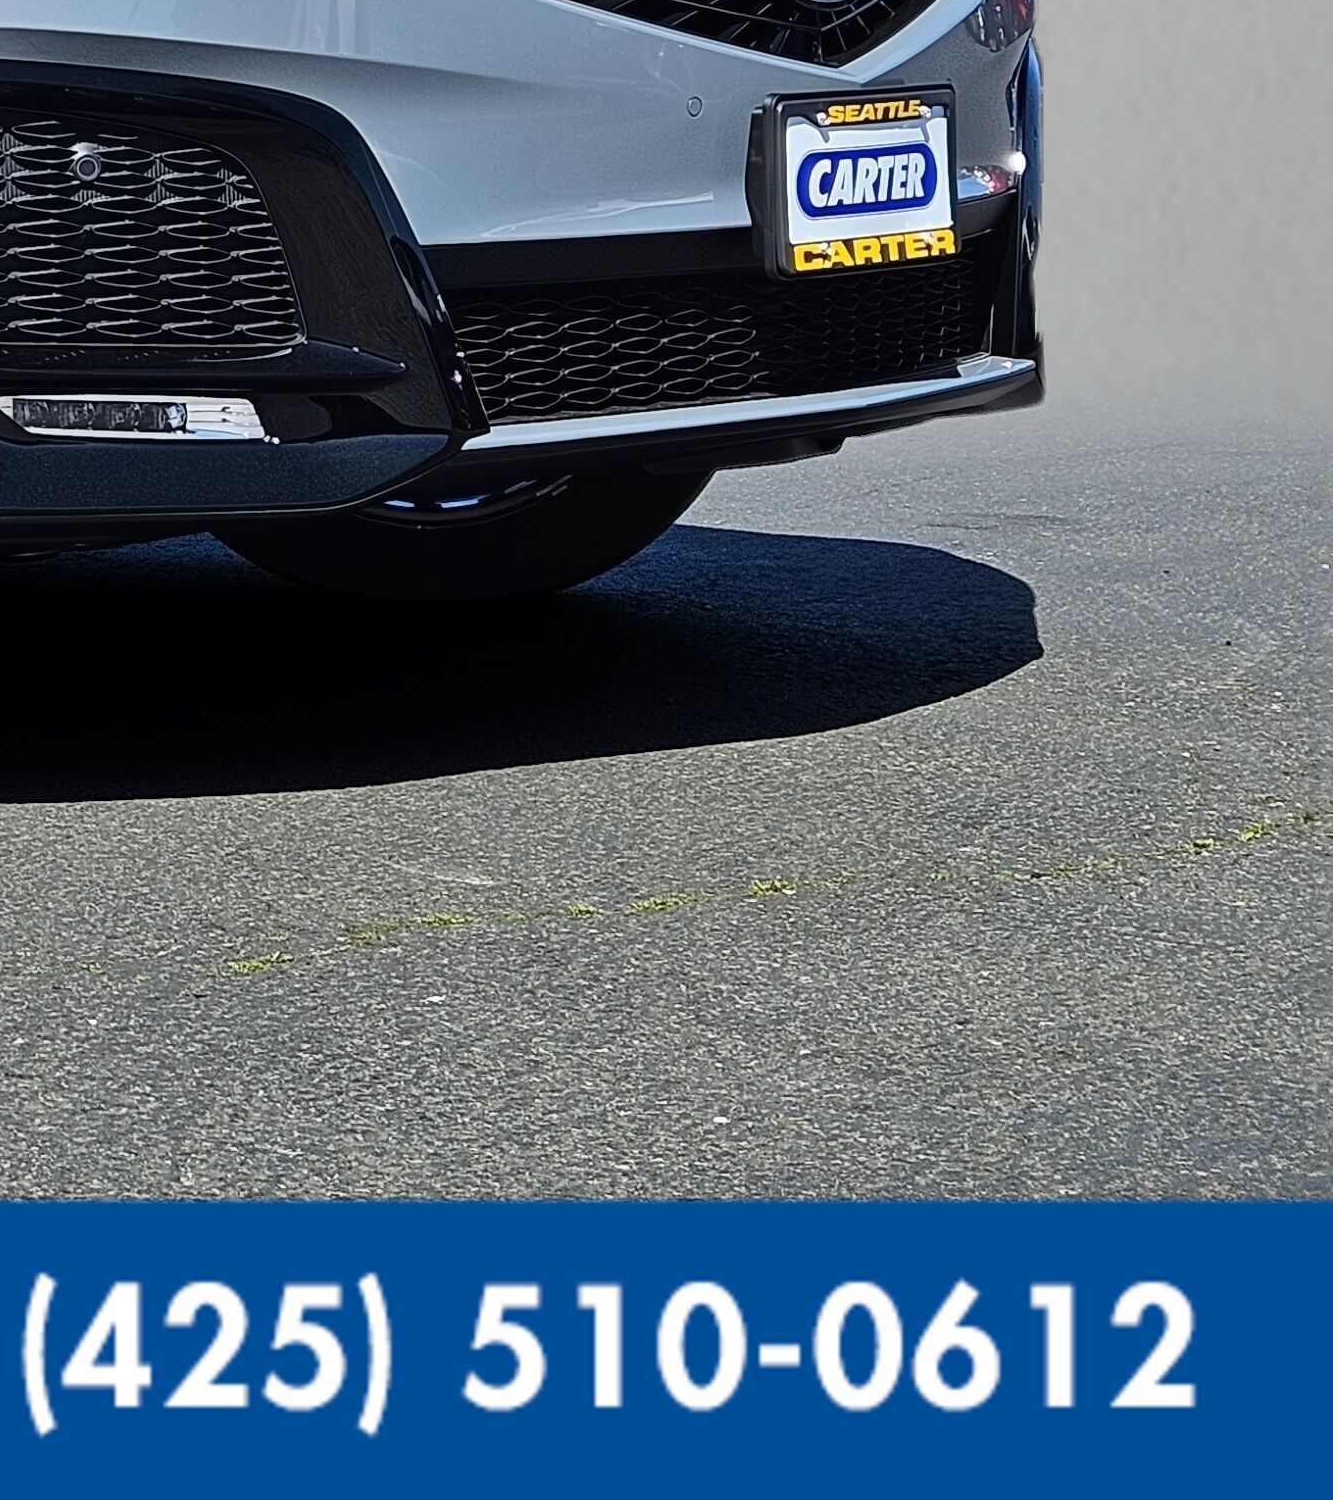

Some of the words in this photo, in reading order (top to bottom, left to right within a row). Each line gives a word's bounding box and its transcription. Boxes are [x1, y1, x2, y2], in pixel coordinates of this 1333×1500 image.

[827, 100, 921, 124] SEATTLE
[808, 152, 926, 208] CARTER
[793, 229, 956, 272] CARTER
